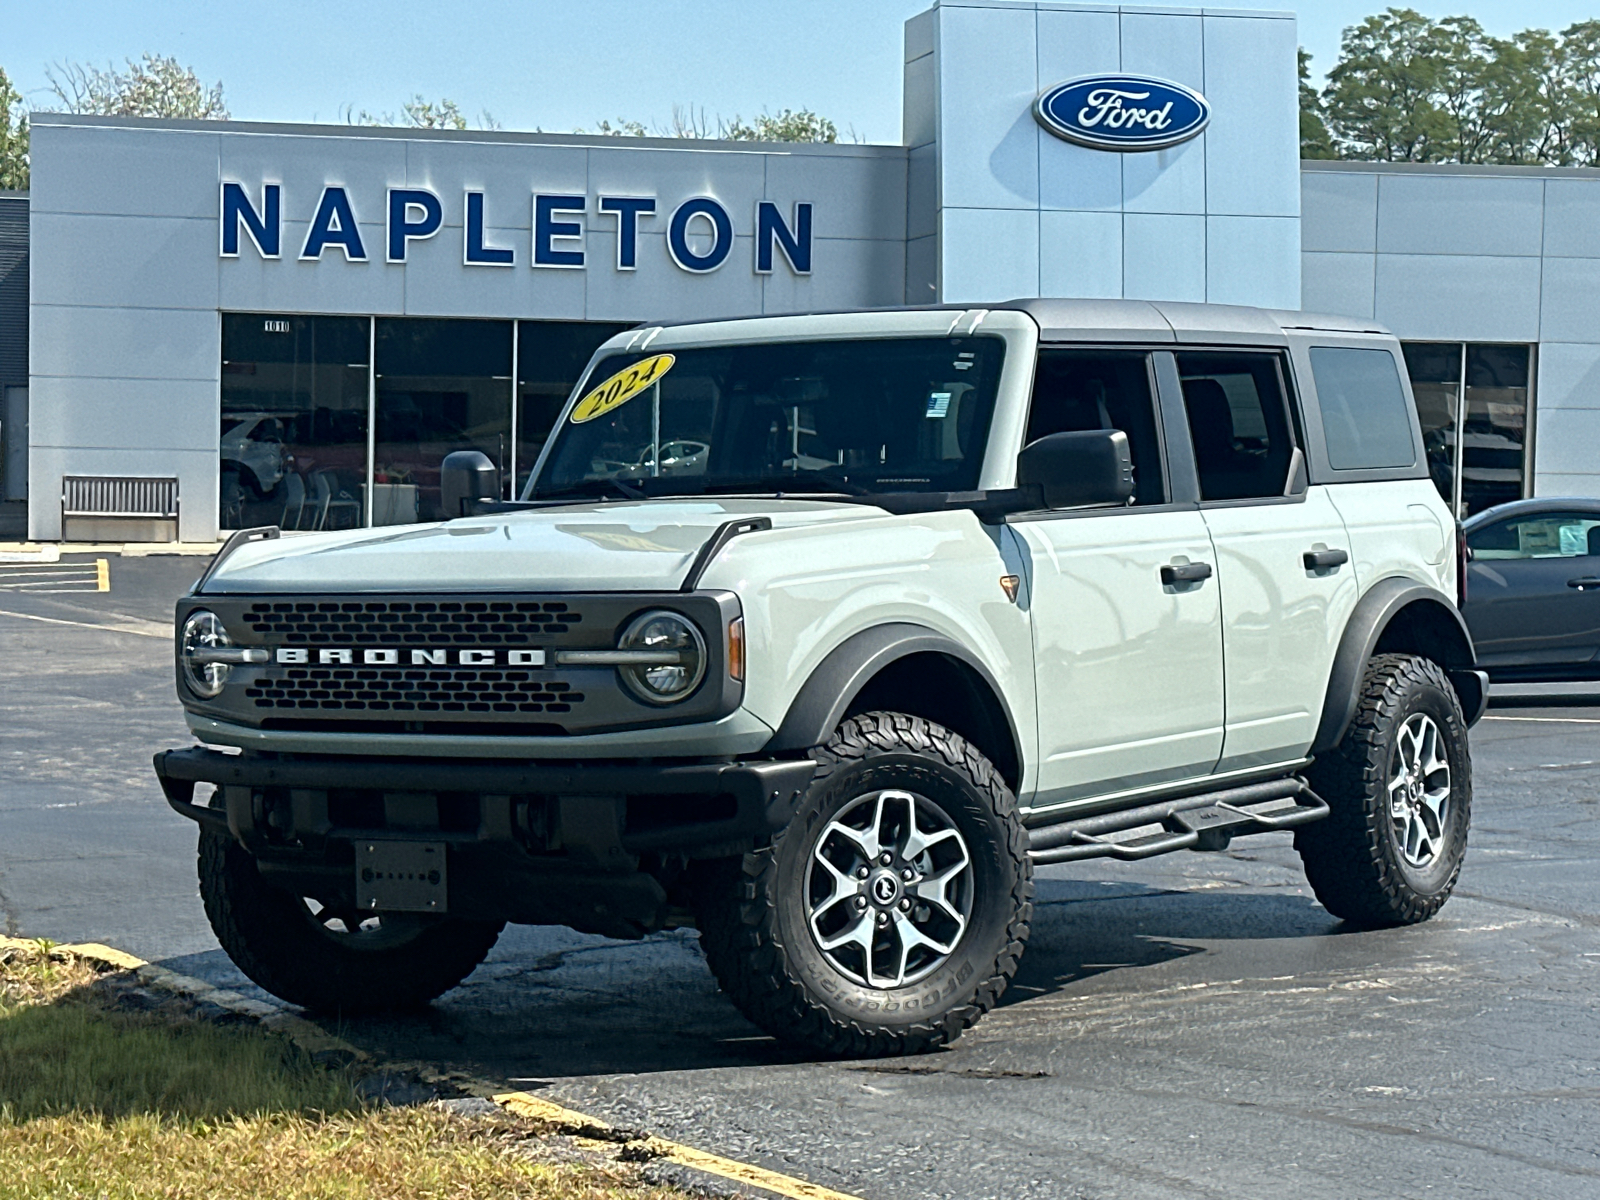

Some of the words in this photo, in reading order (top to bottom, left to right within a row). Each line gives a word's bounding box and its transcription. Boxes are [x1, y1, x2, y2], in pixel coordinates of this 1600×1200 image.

[1078, 89, 1174, 130] Ford
[219, 181, 813, 275] NAPLETON
[265, 321, 289, 331] 1010
[587, 357, 660, 417] 2024
[276, 648, 546, 666] BRONCO
